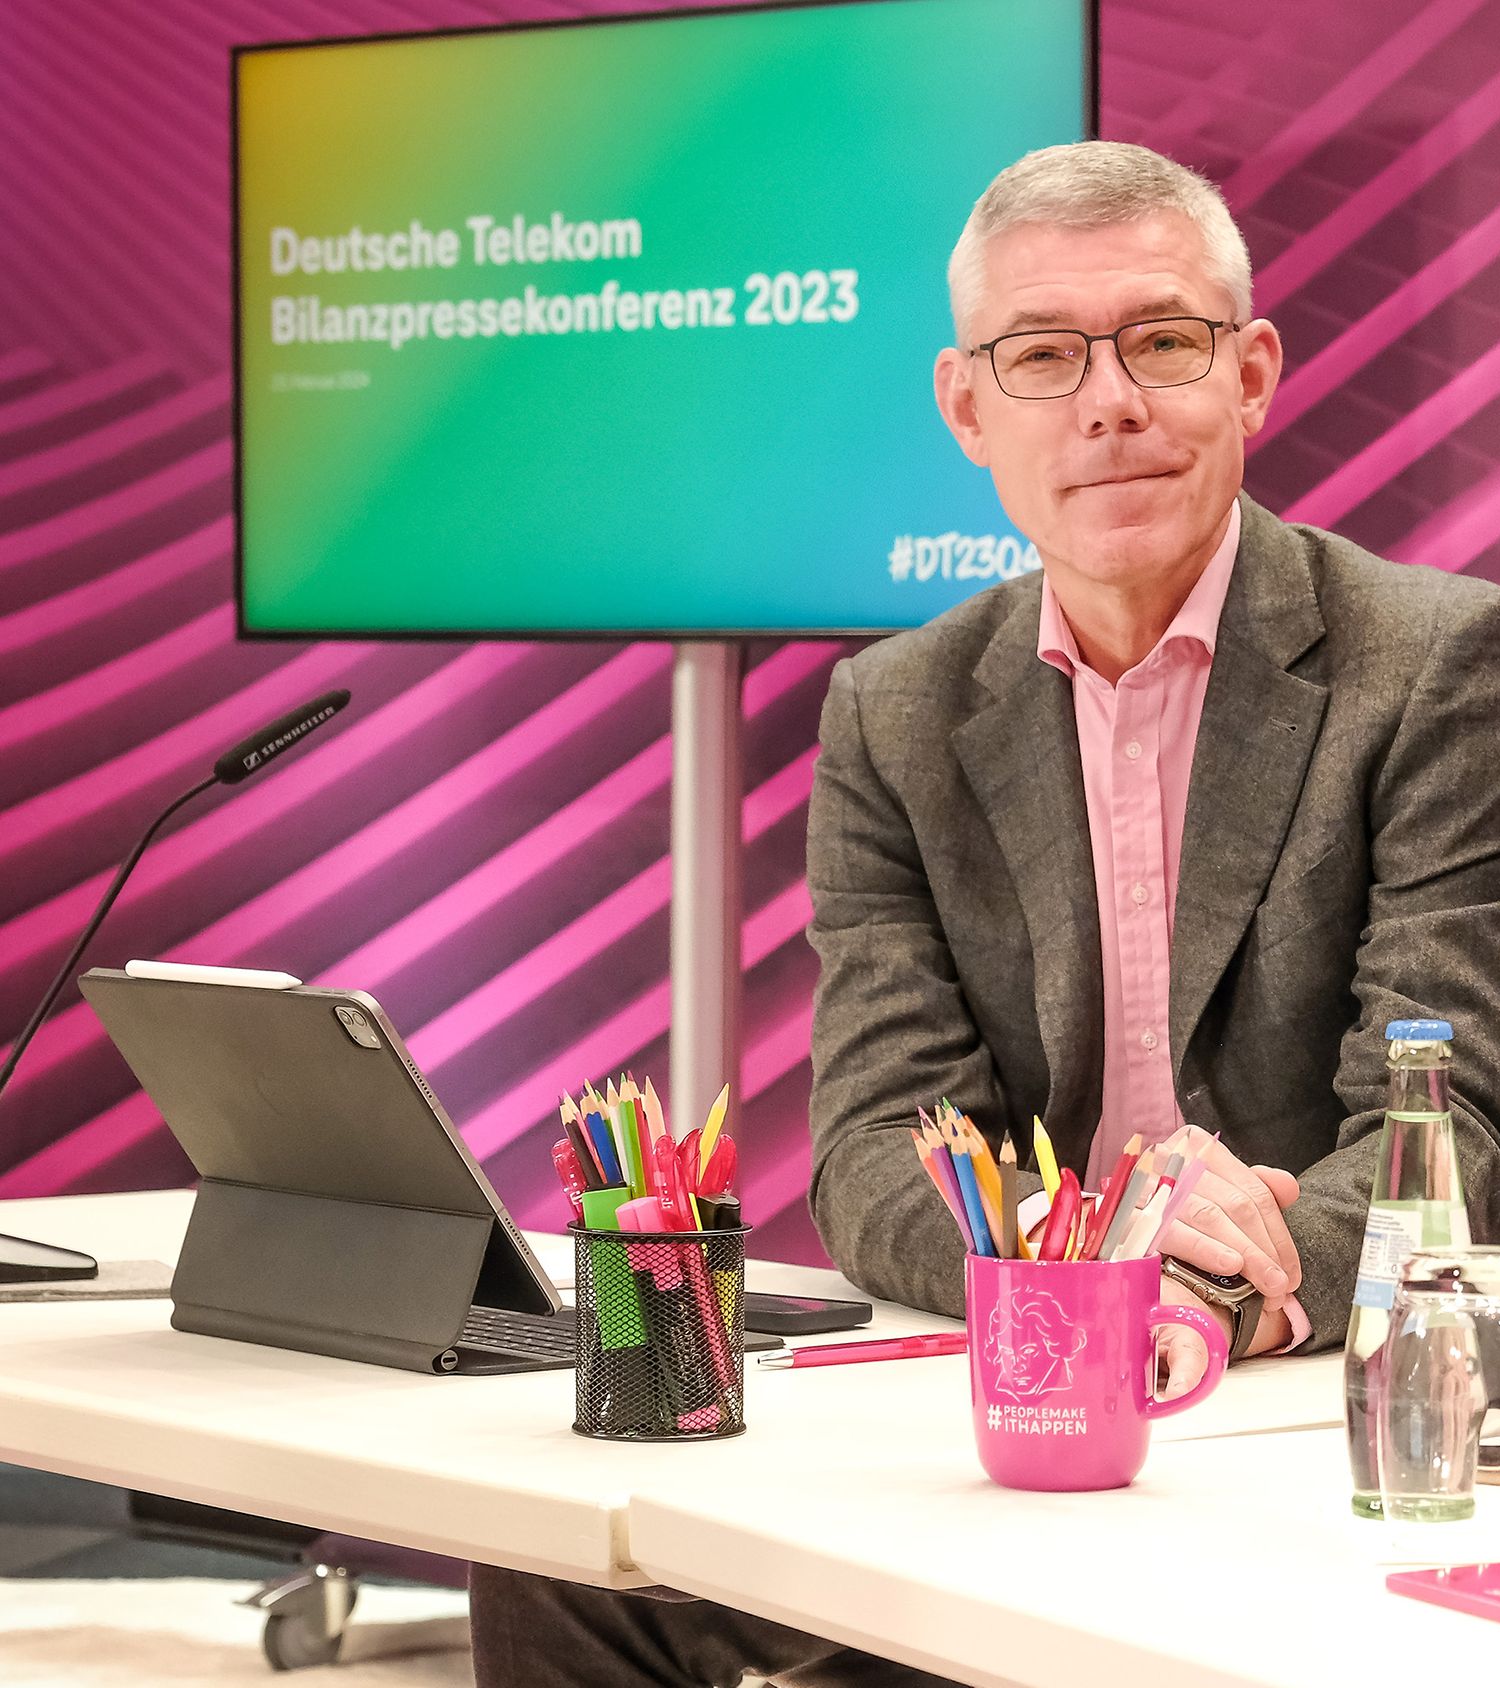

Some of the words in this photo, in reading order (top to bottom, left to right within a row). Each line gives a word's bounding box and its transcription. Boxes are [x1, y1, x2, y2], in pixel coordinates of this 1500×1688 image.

[271, 219, 460, 276] Deutsche
[465, 211, 643, 266] Telekom
[271, 279, 736, 350] Bilanzpressekonferenz
[744, 268, 860, 326] 2023
[261, 706, 335, 757] SENNHEISER
[1004, 1419, 1087, 1435] ITHAPPEN
